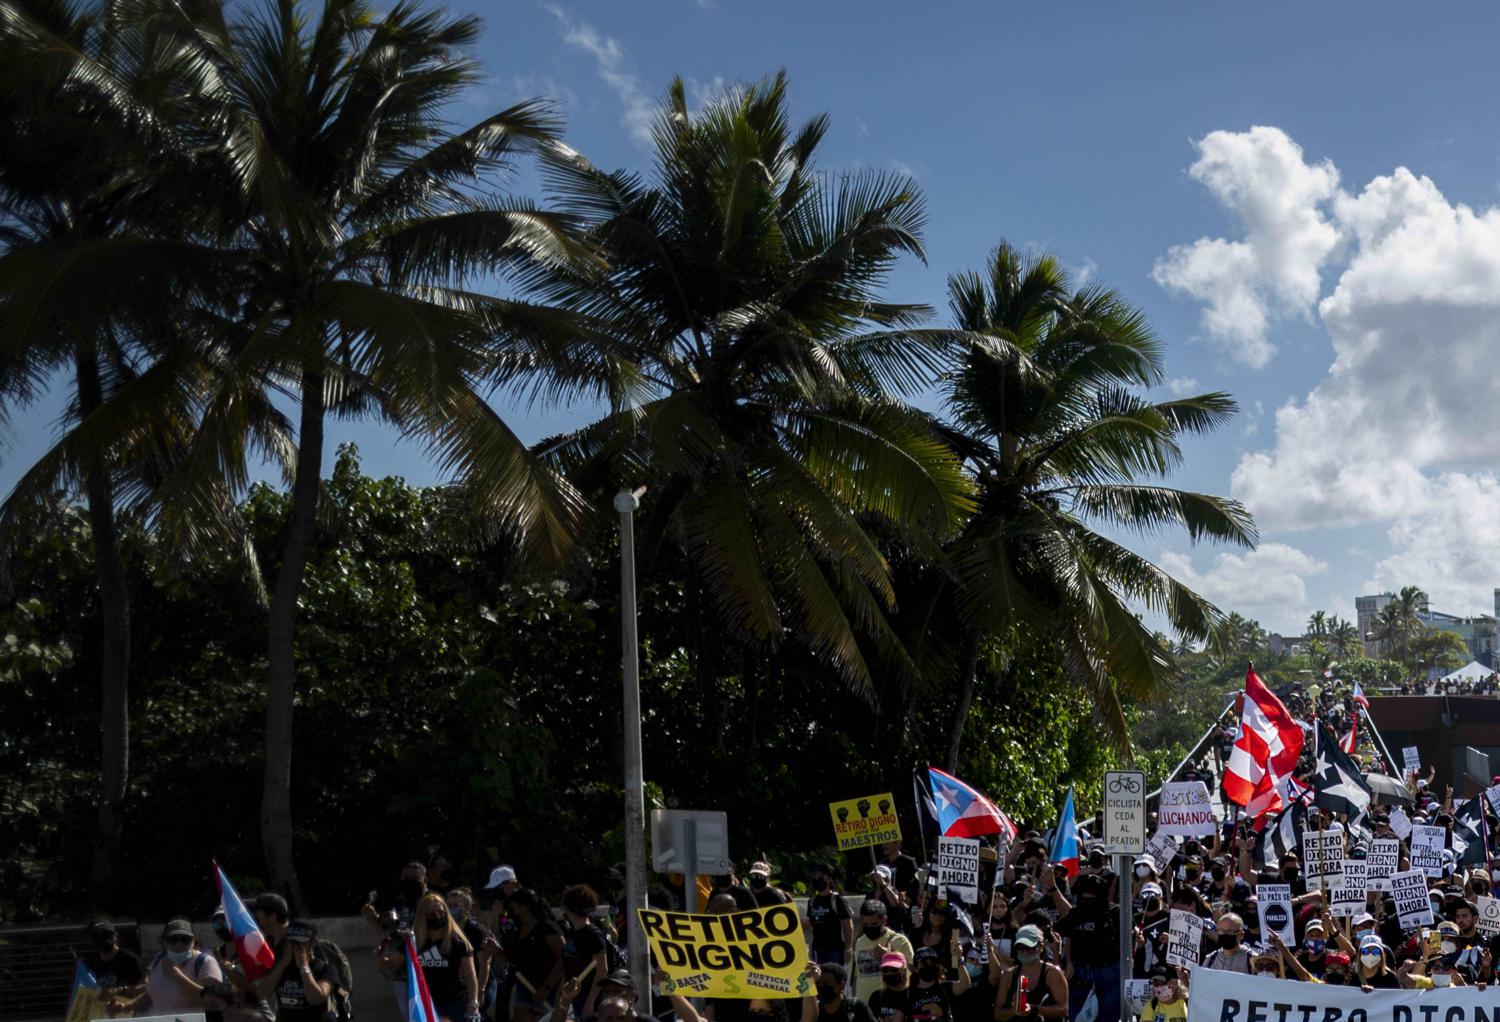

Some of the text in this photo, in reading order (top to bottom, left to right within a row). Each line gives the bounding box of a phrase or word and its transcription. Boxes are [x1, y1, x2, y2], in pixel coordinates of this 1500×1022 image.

[1108, 799, 1142, 808] CICLISTA
[1115, 812, 1135, 820] CEDA
[1160, 811, 1212, 825] LUCHANDO
[835, 814, 897, 834] RETIRO DIGNO
[1120, 825, 1129, 833] AL
[841, 830, 898, 849] MAESTROS
[1110, 837, 1140, 845] PEATON
[940, 843, 978, 856] RETIRO
[1368, 844, 1398, 853] RETIRO
[940, 856, 977, 871] DIGNO
[1367, 856, 1397, 865] DIGNO
[1413, 857, 1441, 868] AHORA
[1345, 865, 1365, 875] TIRO
[1367, 867, 1395, 876] AHORA
[941, 870, 976, 884] AHORA
[1345, 877, 1365, 888] GNO
[1391, 874, 1424, 889] RETIRO
[1334, 890, 1365, 900] AHORA
[1394, 887, 1427, 901] DIGNO
[1399, 899, 1428, 912] AHORA
[640, 906, 799, 942] RETIRO
[1478, 918, 1499, 929] USTIC
[658, 940, 796, 971] DIGNO
[1171, 945, 1198, 962] AHORA
[418, 957, 449, 968] didas
[676, 972, 712, 989] BASTA
[747, 971, 791, 985] JUSTICIA
[693, 983, 710, 993] YA
[746, 979, 791, 993] SALARIAL
